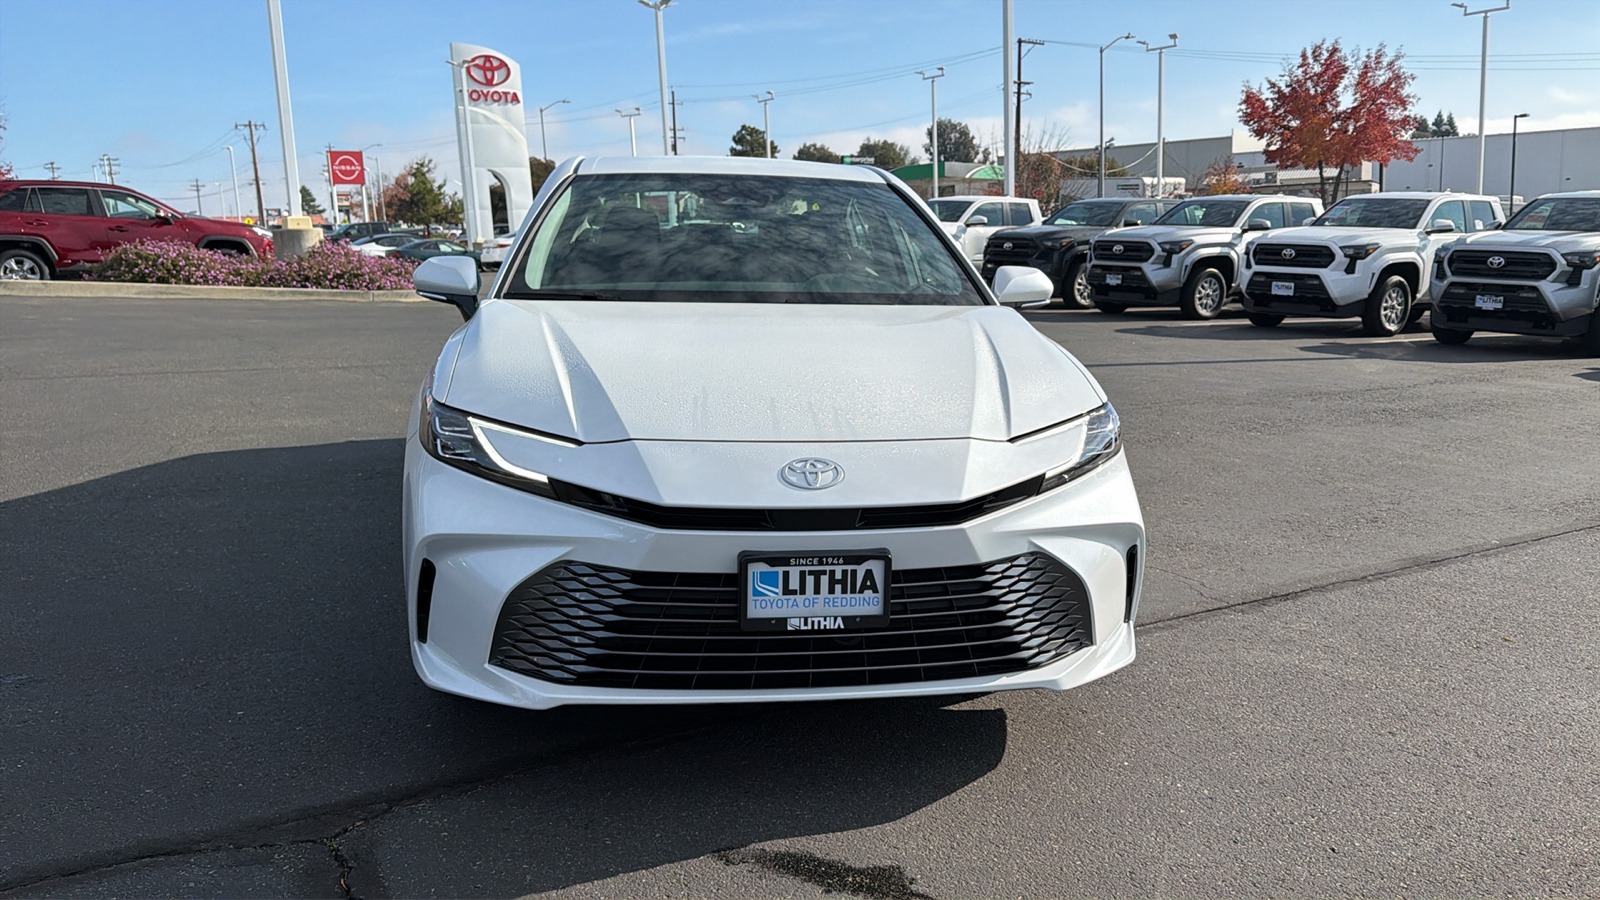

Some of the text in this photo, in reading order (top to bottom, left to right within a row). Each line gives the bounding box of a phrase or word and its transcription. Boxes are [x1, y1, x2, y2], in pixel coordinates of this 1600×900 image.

[460, 88, 521, 104] OYOTA
[790, 557, 844, 566] SINCE 1946
[782, 568, 880, 596] LITHIA
[752, 596, 880, 610] TOYOTA OF REDDING
[800, 616, 845, 630] LITHIA
